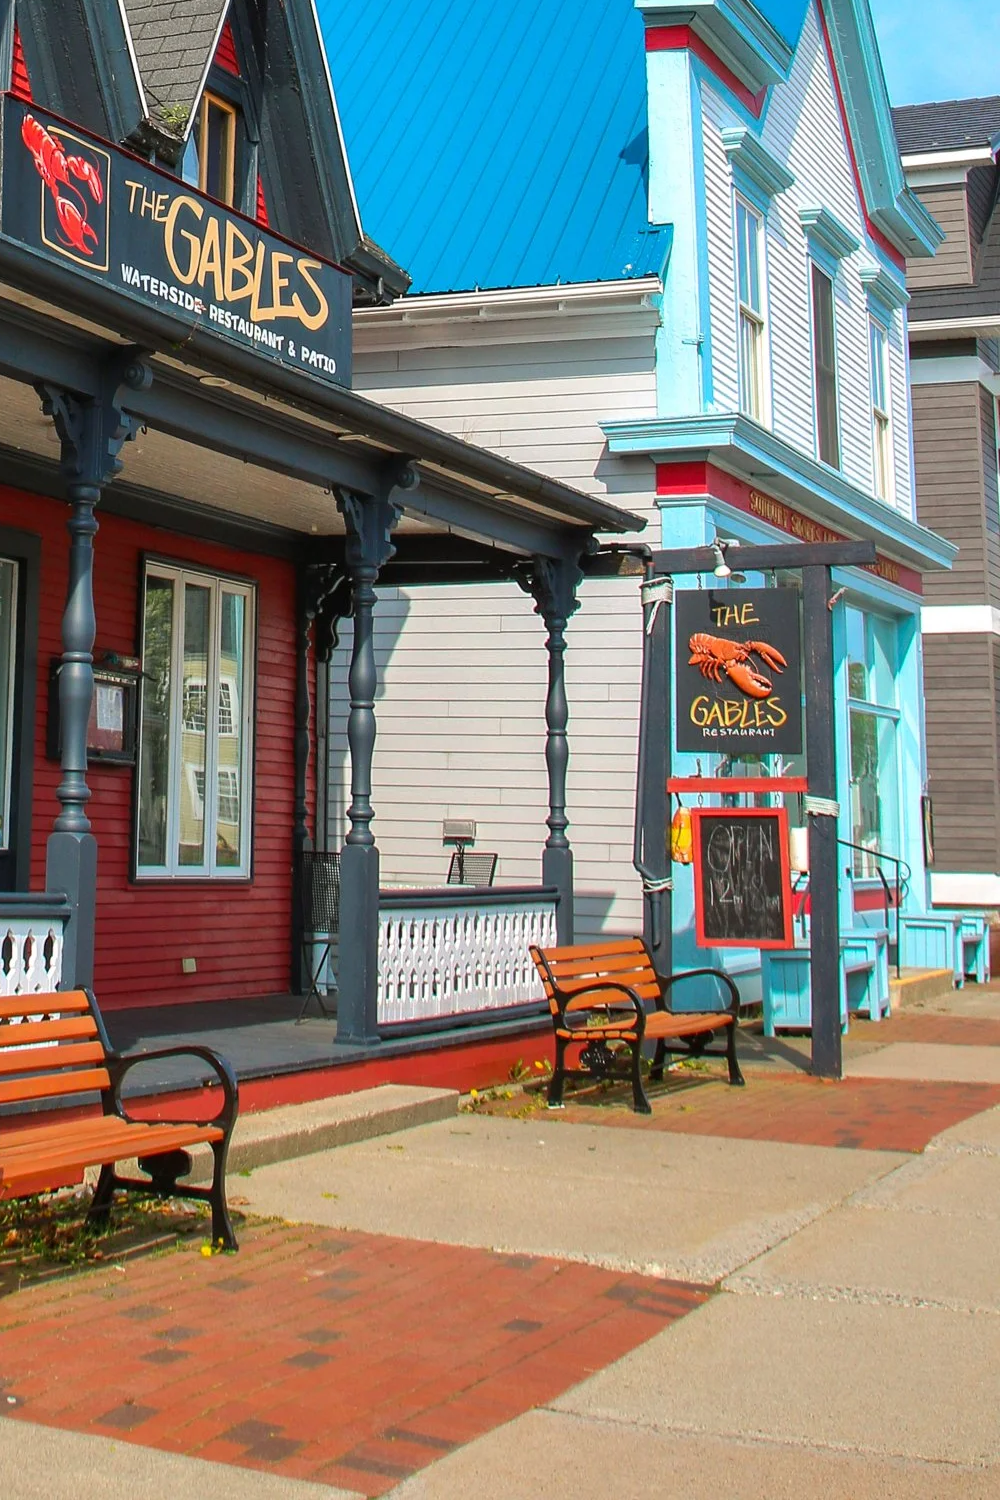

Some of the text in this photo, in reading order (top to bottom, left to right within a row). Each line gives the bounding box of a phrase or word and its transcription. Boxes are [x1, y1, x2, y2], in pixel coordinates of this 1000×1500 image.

[125, 180, 329, 331] THE GABLES
[121, 263, 336, 374] WATERSIDE RESTAURANT & PATIO
[712, 603, 760, 627] THE
[690, 695, 788, 728] GABLES
[702, 727, 775, 737] RESTAURANT
[707, 824, 774, 873] OPEN
